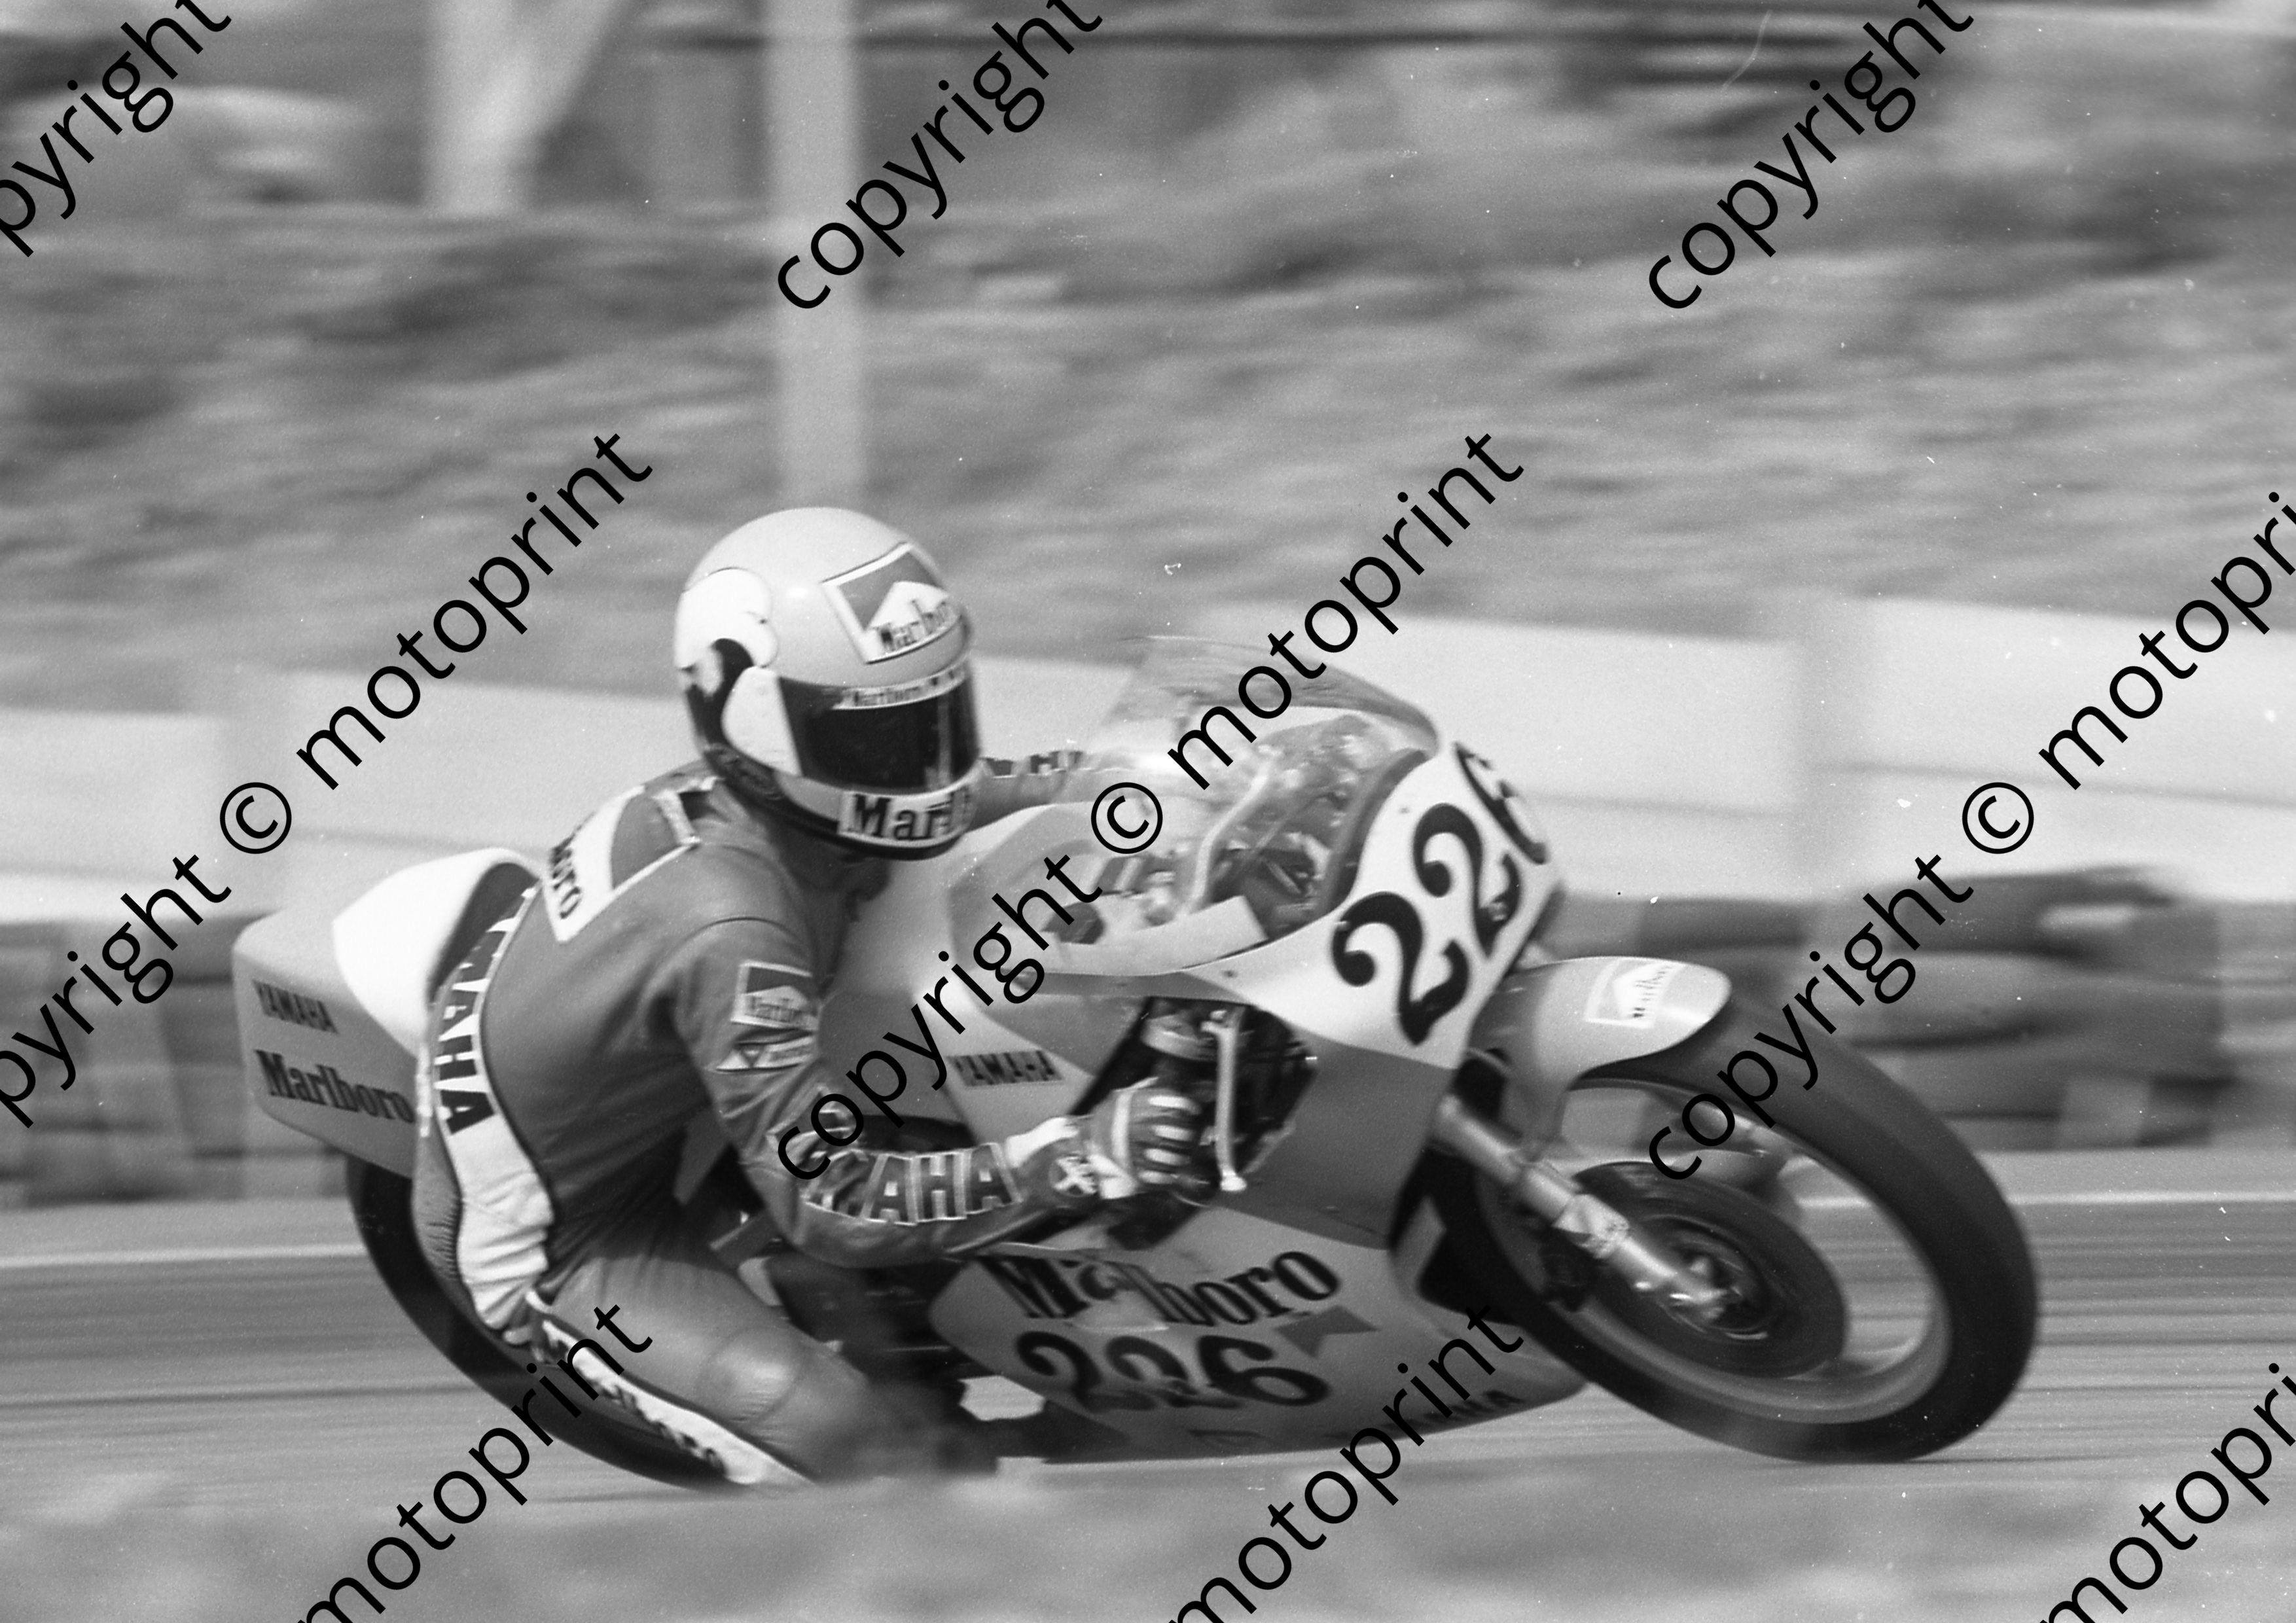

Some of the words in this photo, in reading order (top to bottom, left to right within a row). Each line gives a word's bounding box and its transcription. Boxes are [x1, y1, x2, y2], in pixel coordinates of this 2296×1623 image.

[1331, 741, 1551, 1047] 226
[253, 1048, 416, 1124] Marlboro
[1016, 1330, 1329, 1413] 226
